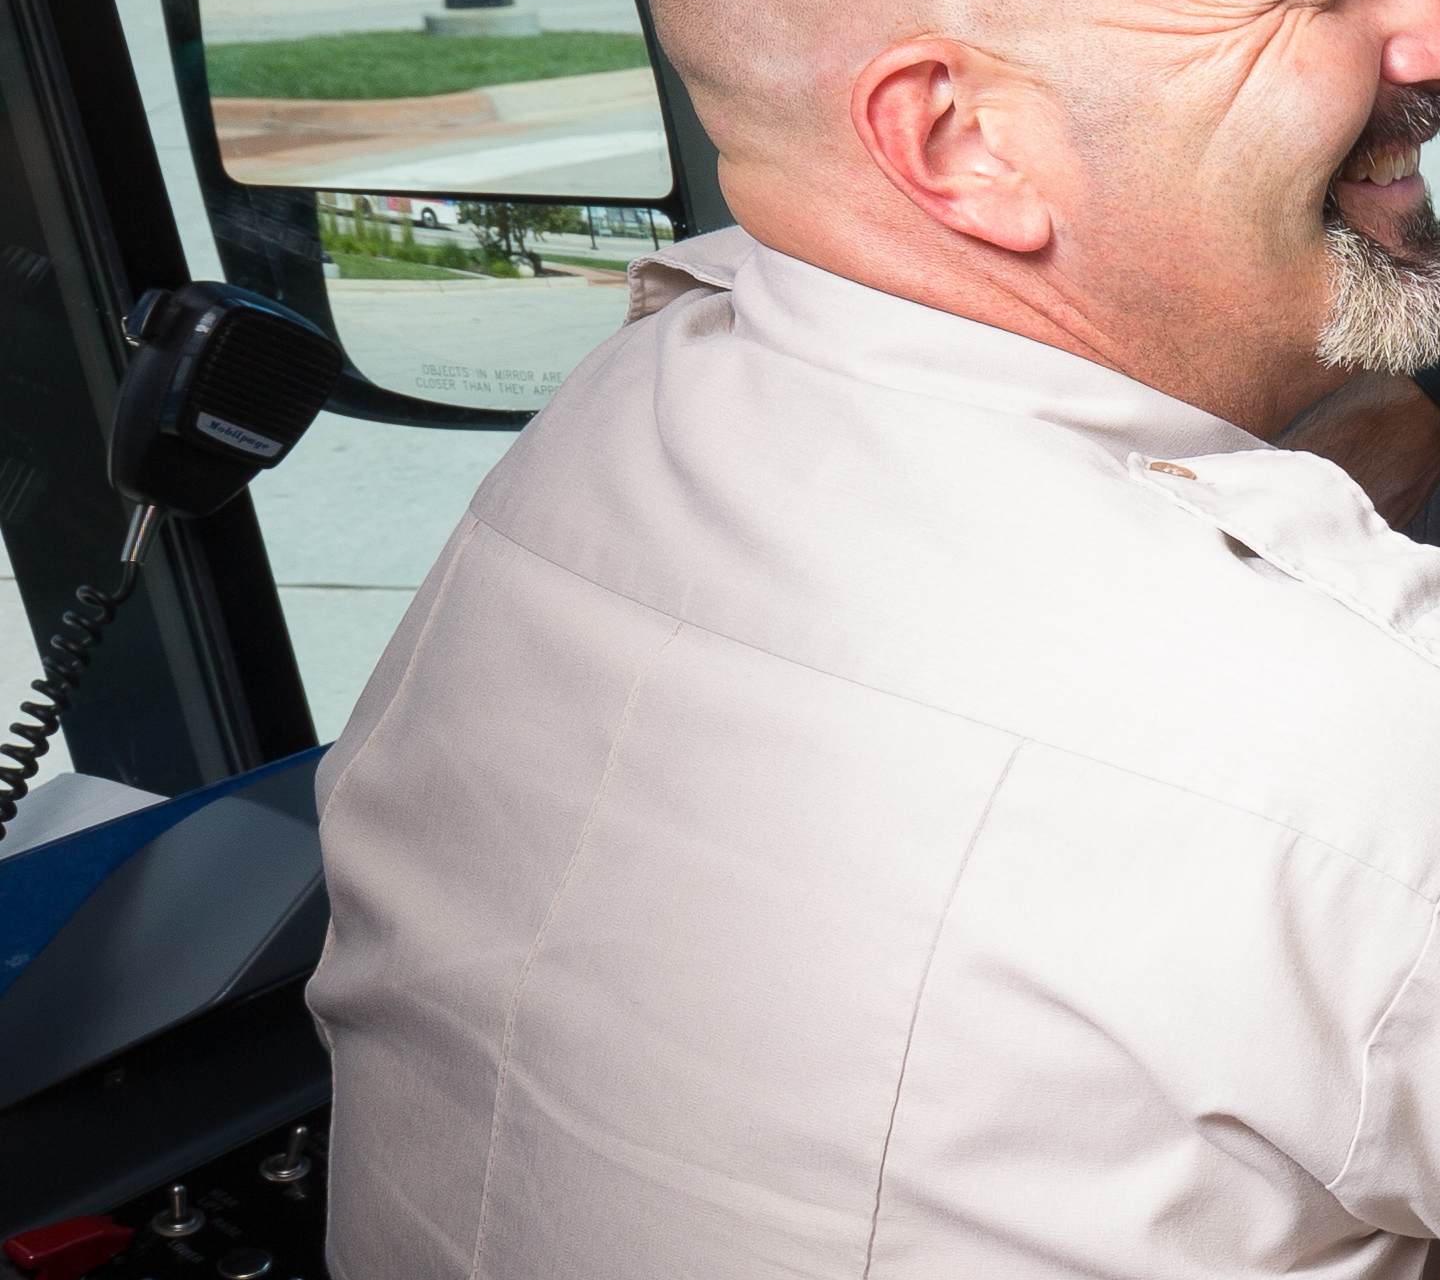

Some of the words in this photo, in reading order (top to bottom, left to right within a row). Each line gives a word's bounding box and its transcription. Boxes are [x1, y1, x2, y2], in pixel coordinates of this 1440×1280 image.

[422, 364, 472, 381] OBJECTS
[475, 367, 490, 380] IN
[493, 368, 536, 383] MIRROR
[542, 370, 563, 384] ARE
[415, 376, 456, 391] CLOSER
[463, 379, 493, 394] THAN
[499, 381, 525, 397] THEY
[532, 383, 560, 397] APP
[209, 419, 270, 451] Mobilpage
